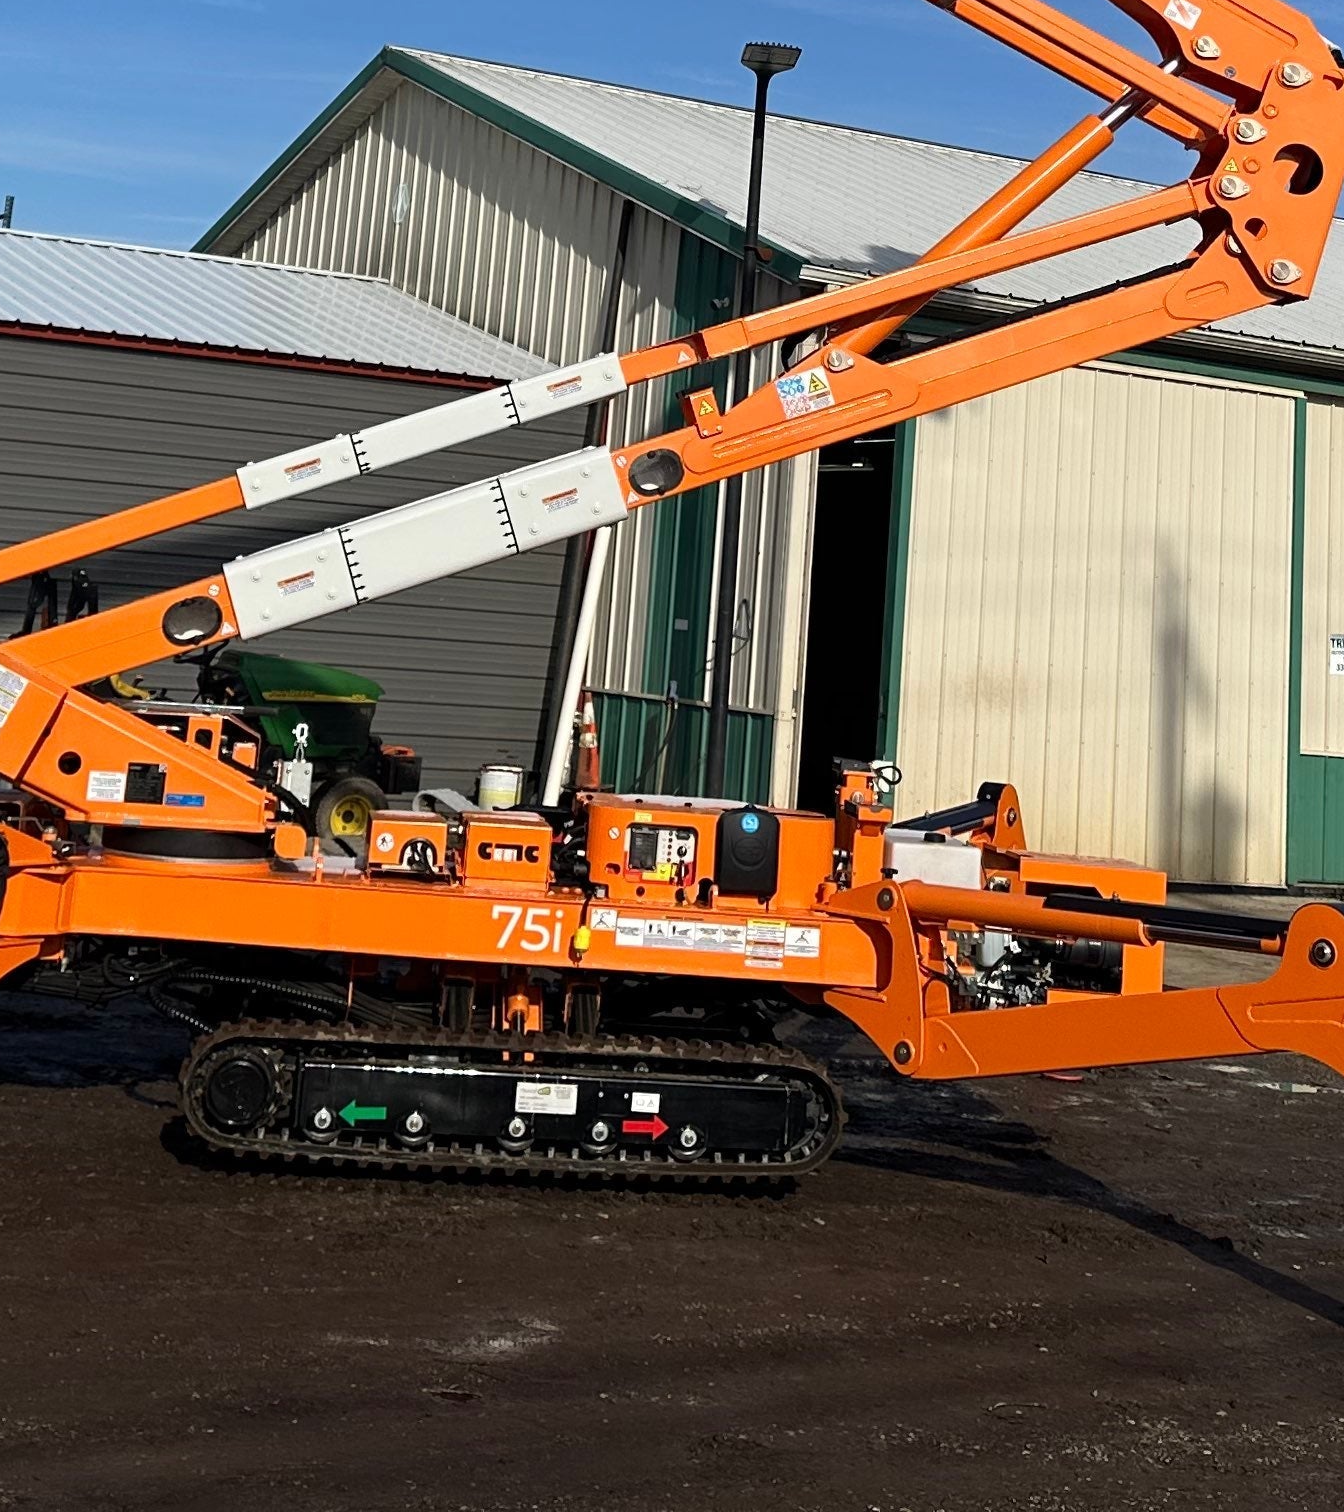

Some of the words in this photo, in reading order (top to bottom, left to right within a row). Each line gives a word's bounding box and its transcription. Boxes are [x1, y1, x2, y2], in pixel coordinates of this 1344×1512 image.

[1330, 638, 1344, 649] TRI
[478, 842, 540, 863] cmc
[491, 904, 563, 954] 75i
